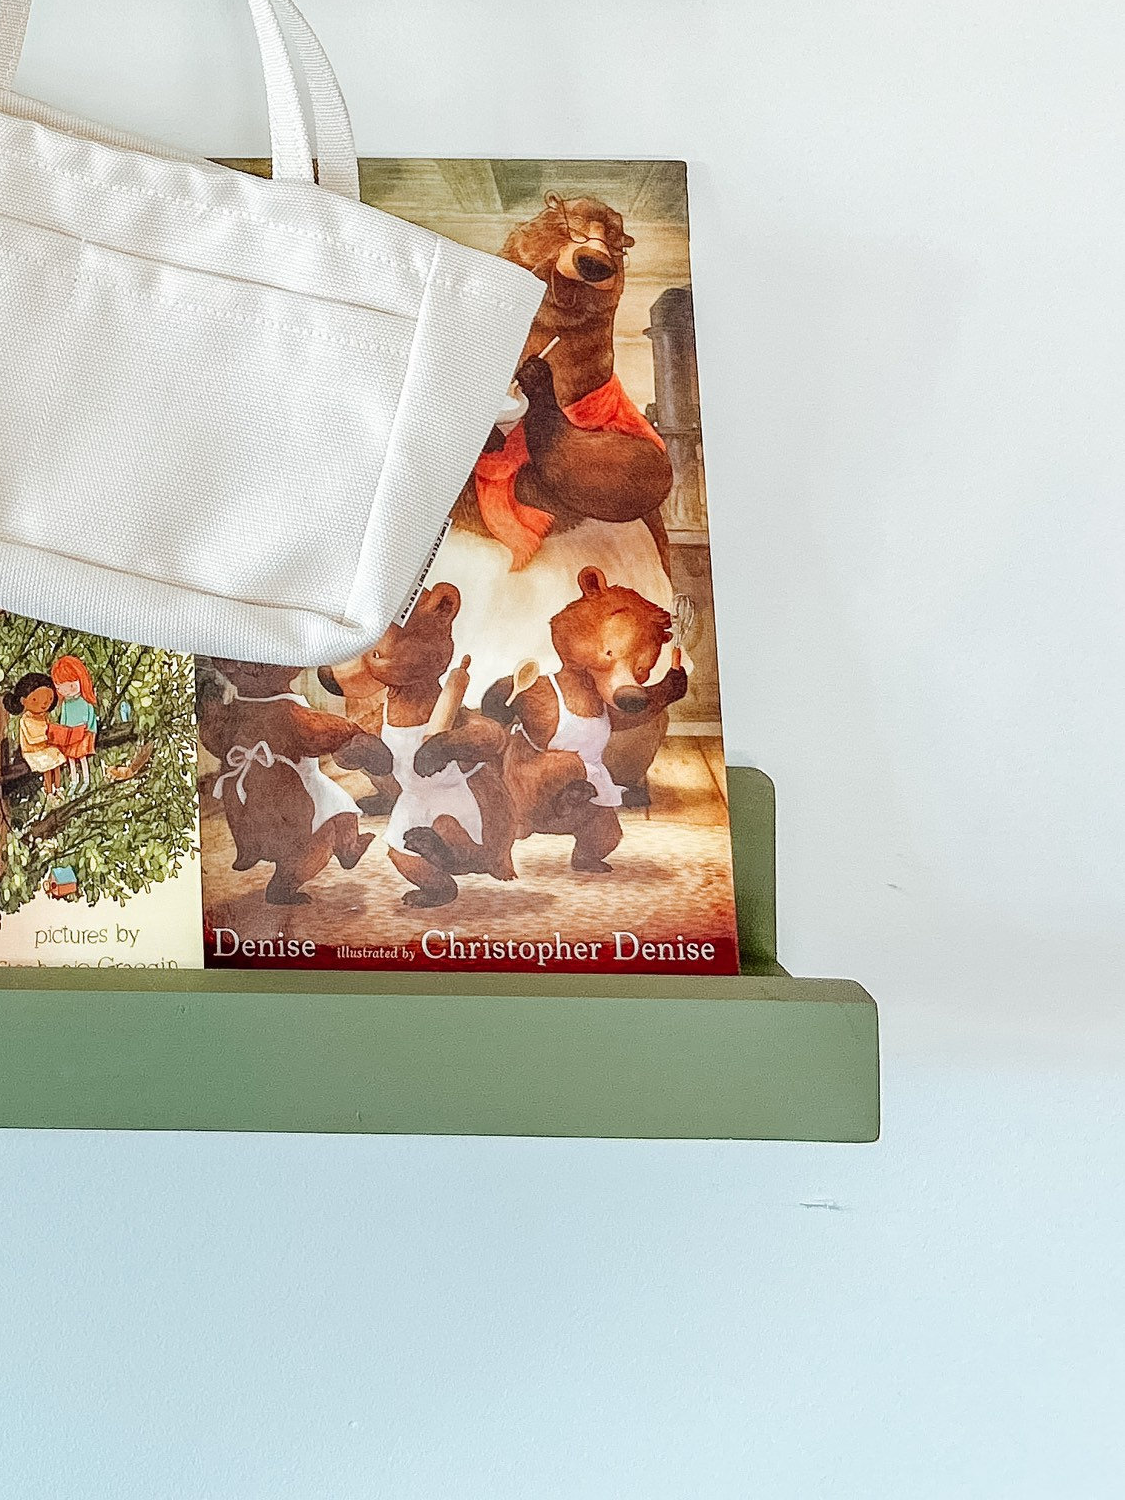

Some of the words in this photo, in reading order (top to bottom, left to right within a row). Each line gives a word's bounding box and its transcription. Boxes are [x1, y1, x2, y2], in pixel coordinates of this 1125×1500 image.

[35, 925, 108, 949] pictures
[116, 923, 141, 948] by
[212, 928, 316, 959] Denise
[336, 945, 400, 960] illustrated
[402, 946, 416, 962] by
[421, 929, 601, 966] Christopher
[612, 931, 715, 961] Denise
